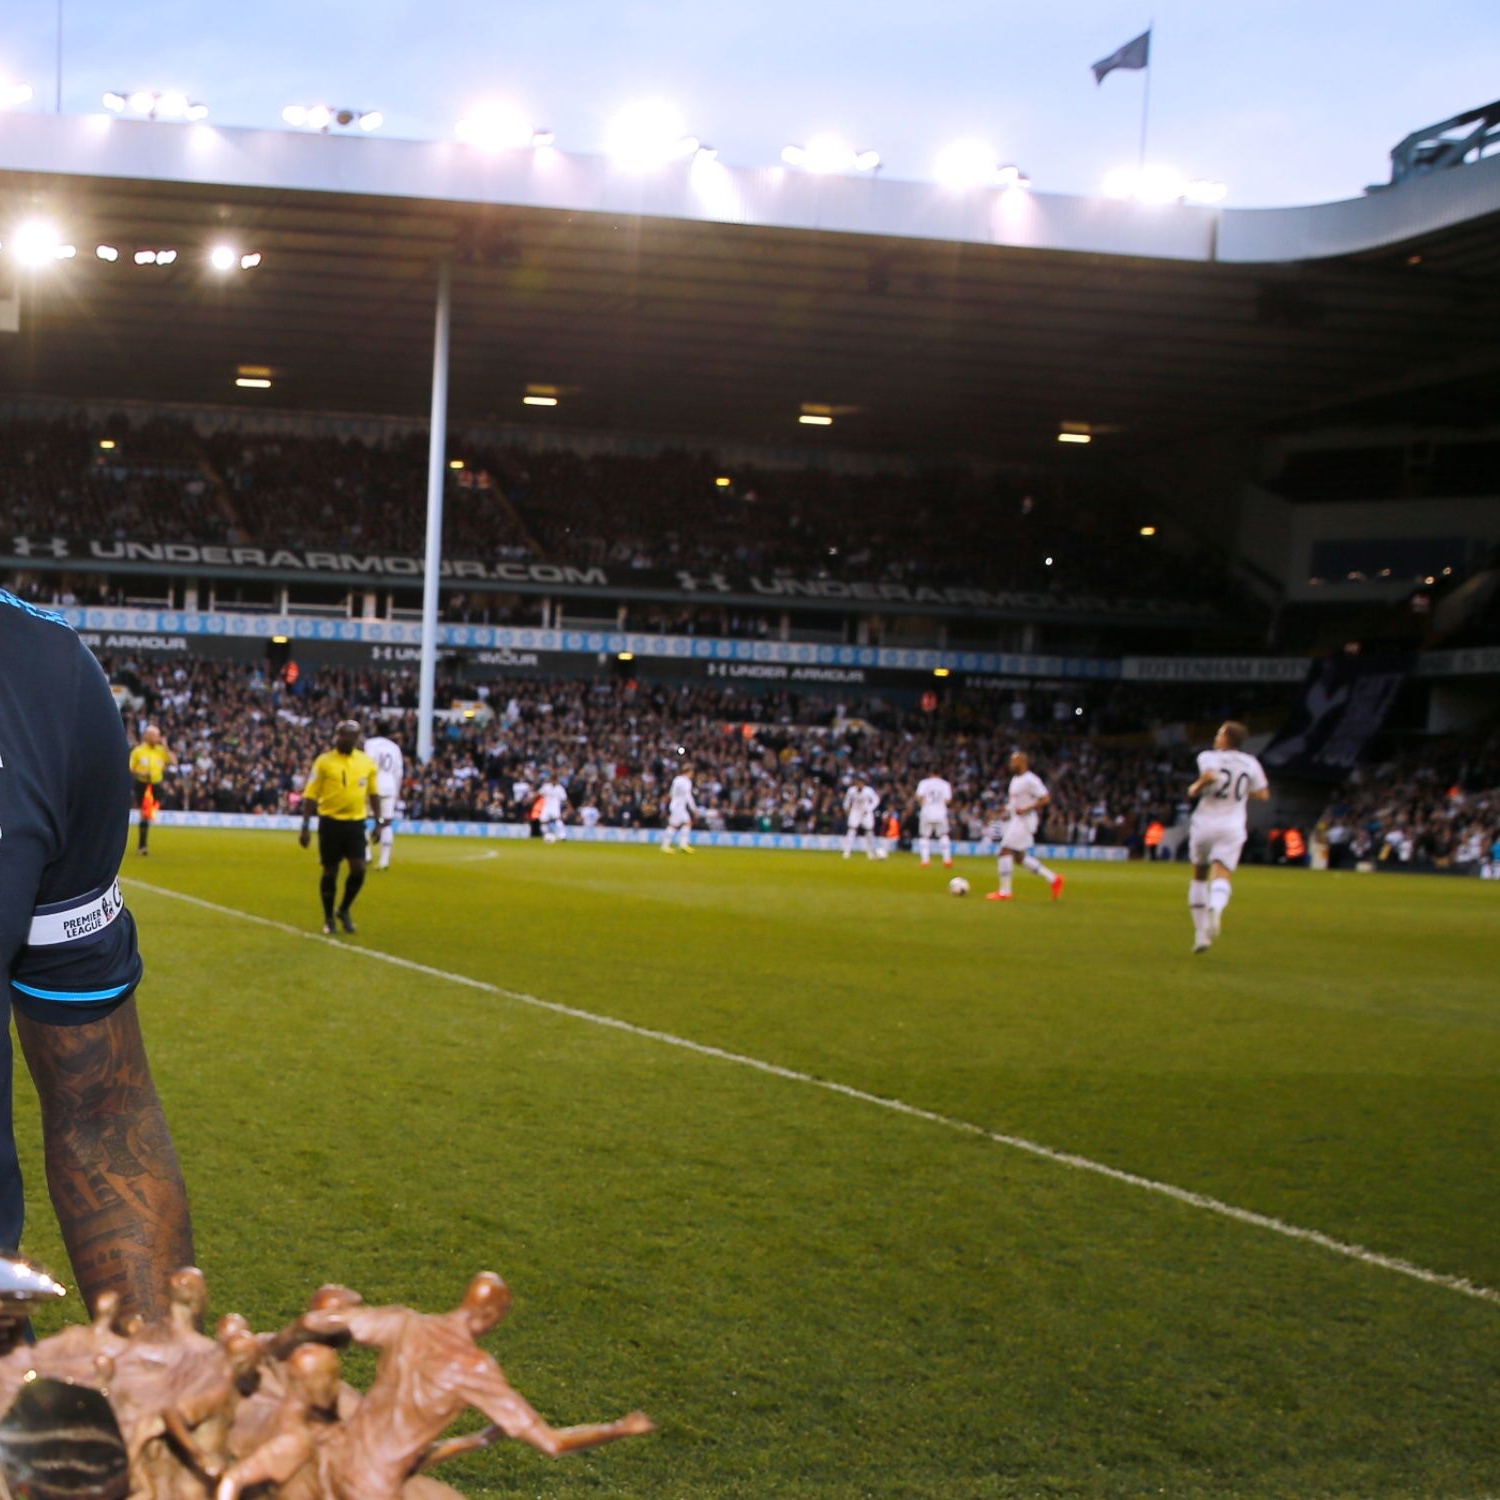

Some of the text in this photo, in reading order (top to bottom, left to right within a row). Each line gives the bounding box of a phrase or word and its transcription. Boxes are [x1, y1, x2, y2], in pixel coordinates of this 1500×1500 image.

[105, 636, 187, 650] ARMOUR
[729, 664, 864, 682] UNDER ARMOUR
[1216, 768, 1251, 802] 20
[63, 909, 102, 930] PREMIER
[66, 919, 103, 938] LEAGUE
